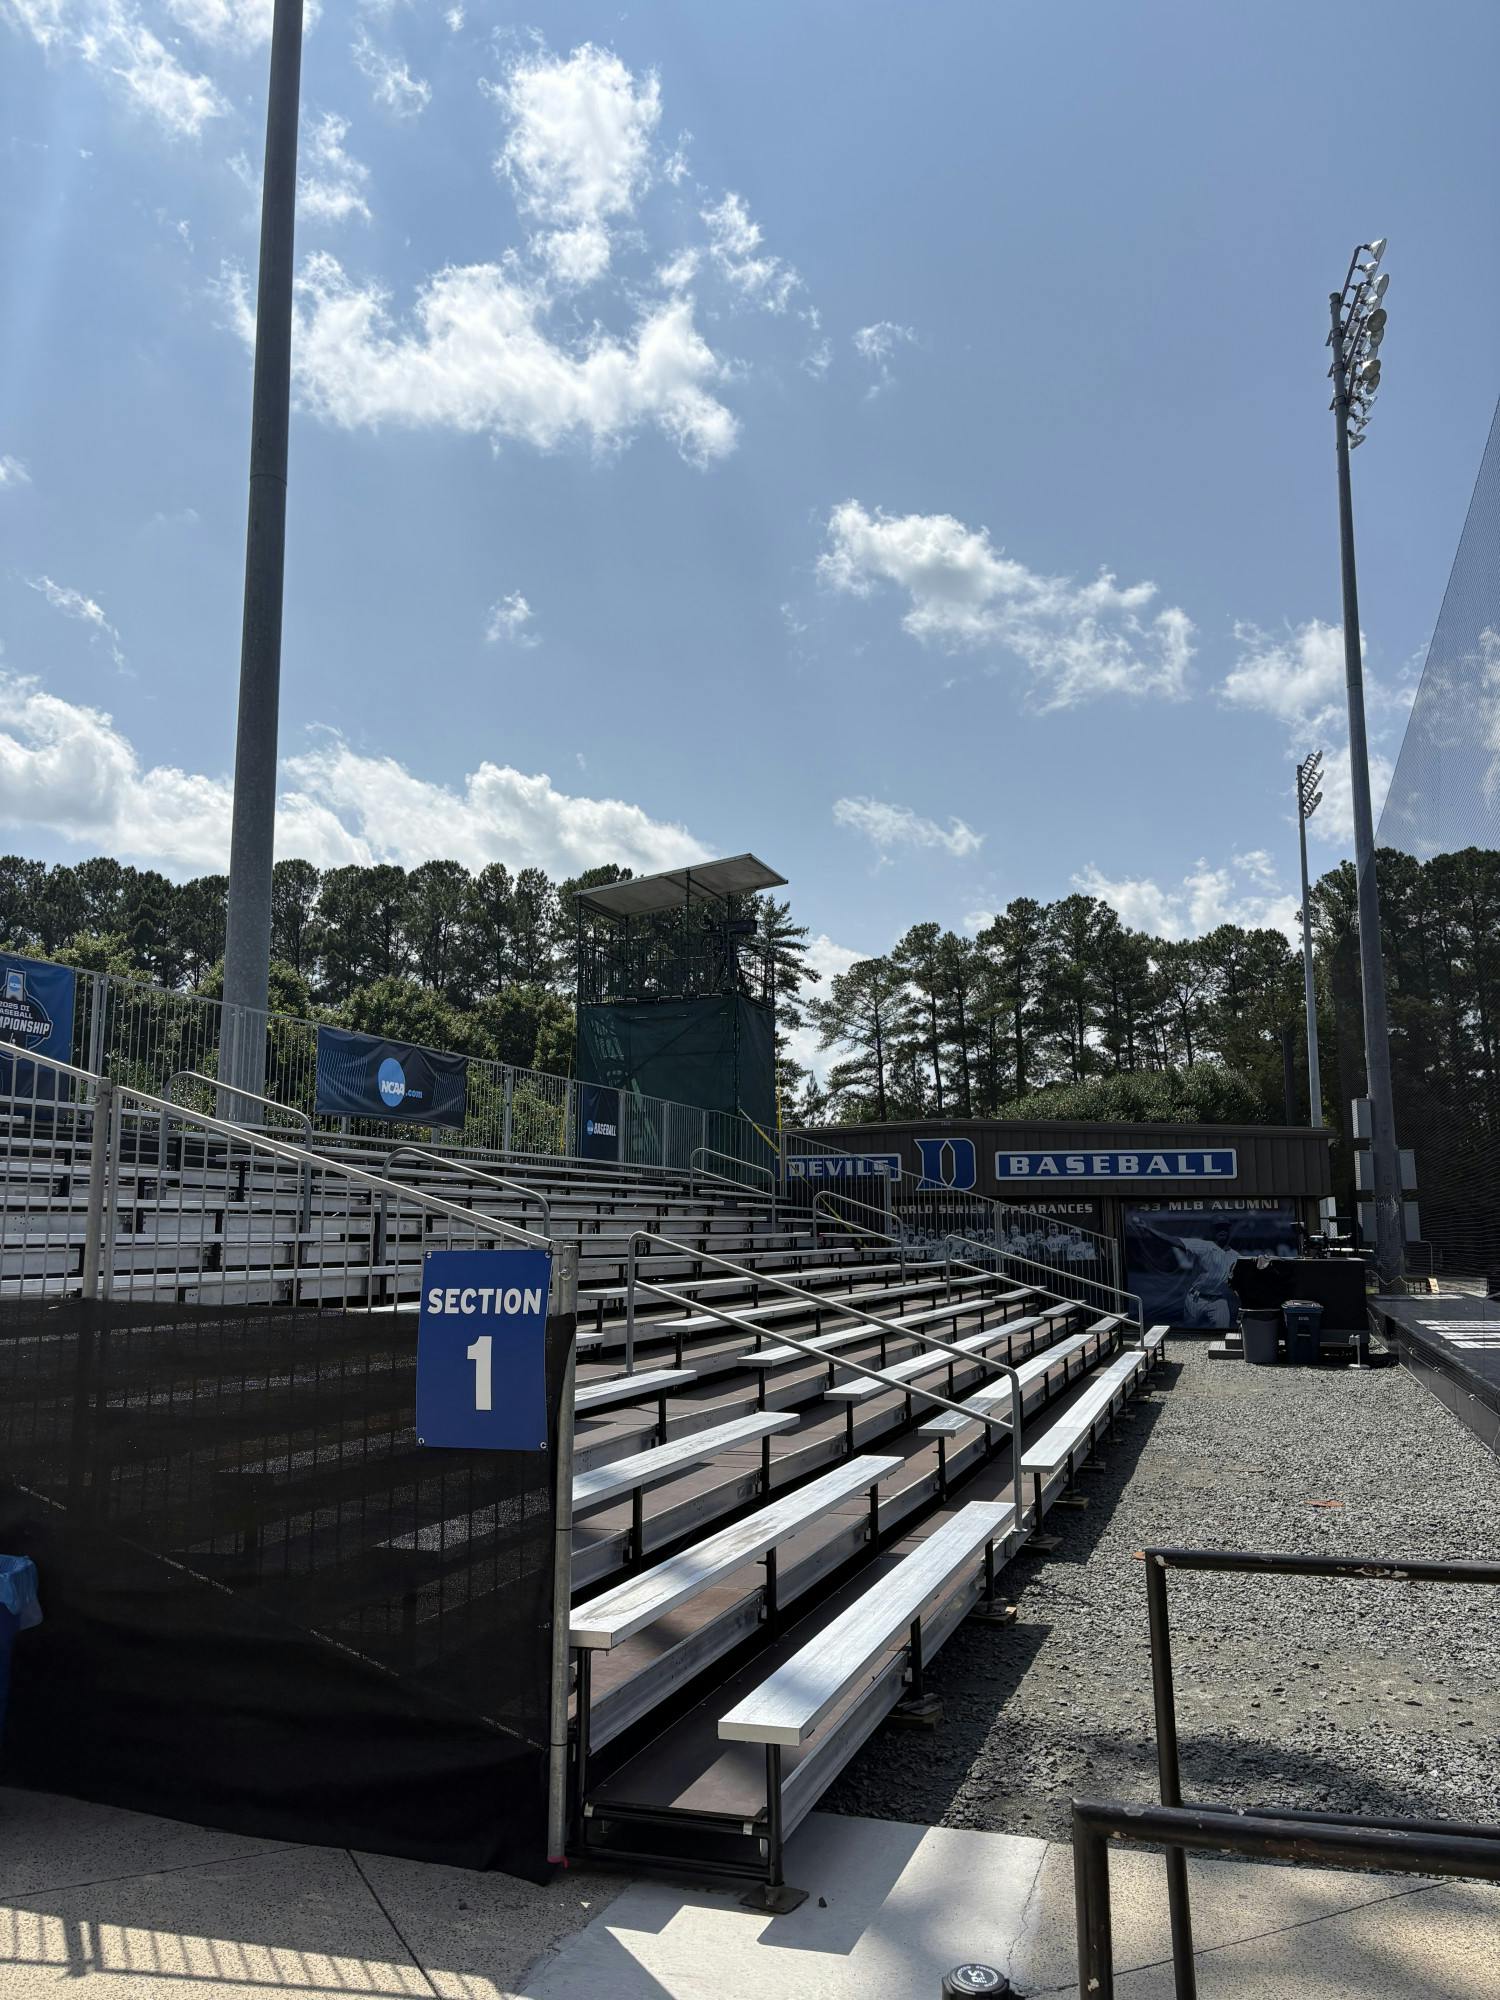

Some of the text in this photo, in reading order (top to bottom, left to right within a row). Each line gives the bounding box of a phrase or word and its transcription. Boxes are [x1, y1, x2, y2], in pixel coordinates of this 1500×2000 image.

[594, 1122, 617, 1137] BASEBALL
[787, 1159, 889, 1177] DEVILS
[1009, 1154, 1221, 1175] BASEBALL
[939, 1204, 986, 1214] SERIES
[992, 1203, 1093, 1214] PPEARANCES
[1168, 1200, 1203, 1211] MLB
[1211, 1199, 1279, 1210] ALUMNI
[427, 1287, 542, 1315] SECTION
[466, 1335, 492, 1411] 1
